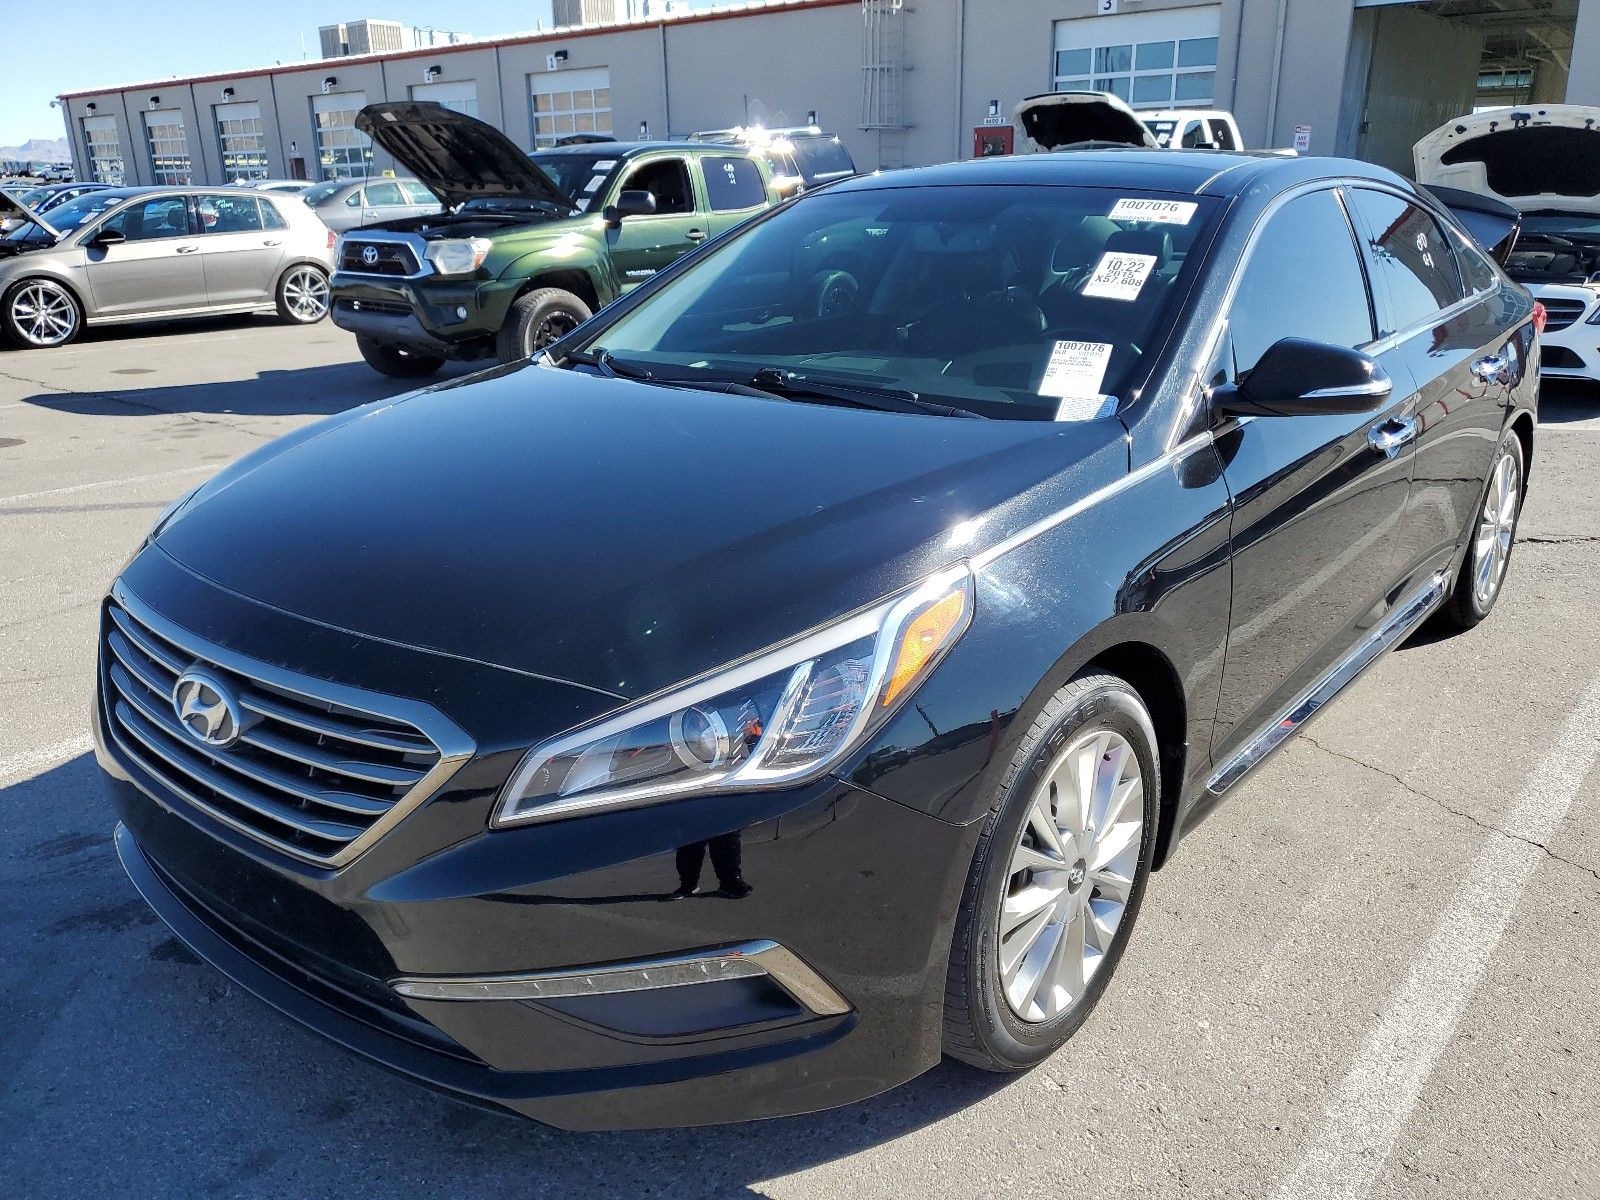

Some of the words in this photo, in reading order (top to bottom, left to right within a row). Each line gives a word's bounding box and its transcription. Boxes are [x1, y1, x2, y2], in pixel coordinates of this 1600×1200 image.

[1121, 200, 1179, 211] 1007076
[1107, 270, 1134, 278] 2015
[1058, 342, 1105, 352] 1007076
